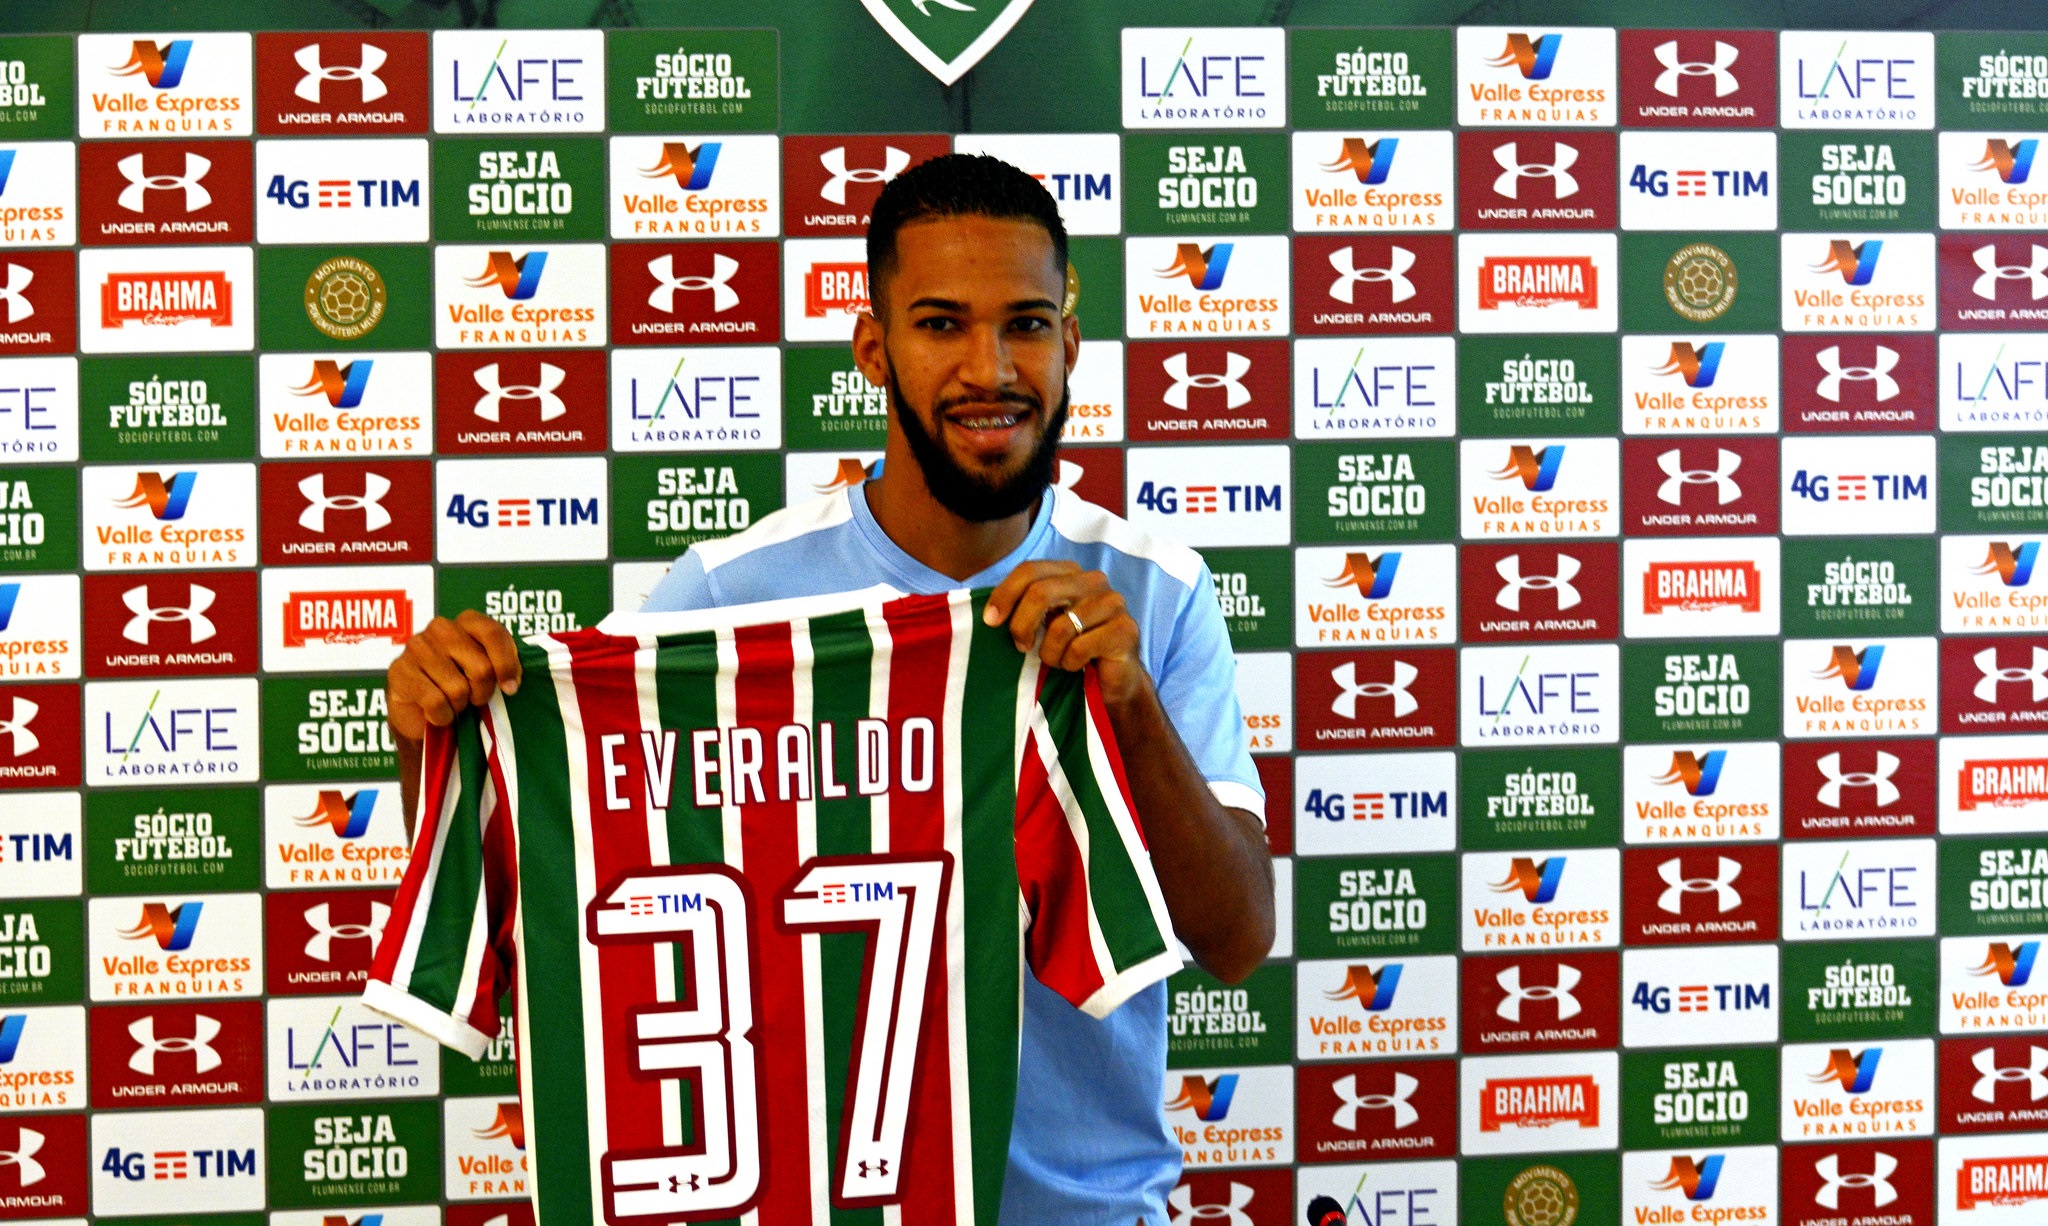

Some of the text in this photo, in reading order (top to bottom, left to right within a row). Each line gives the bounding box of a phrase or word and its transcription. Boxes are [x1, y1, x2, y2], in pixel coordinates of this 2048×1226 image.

[655, 47, 732, 78] SÓCIO
[1140, 44, 1267, 102] LAFE
[1335, 46, 1409, 76] SÓCIO
[452, 47, 584, 106] LAFE
[636, 77, 751, 98] FUTEBOL
[1317, 75, 1427, 96] FUTEBOL
[92, 91, 241, 117] Valle Express
[1470, 82, 1605, 107] Valle Express
[277, 110, 405, 125] UNDER ARMOUR
[452, 108, 584, 125] LABORATÓRIO
[1139, 104, 1266, 120] LABORATÓRIO
[1481, 107, 1598, 123] FRANQUIAS
[103, 117, 233, 134] FRANQUIAS
[478, 151, 560, 178] SEJA
[1167, 146, 1246, 172] SEJA
[1821, 144, 1894, 170] SEJA
[266, 174, 421, 209] 4G TIM
[1053, 173, 1112, 201] TIM
[1158, 173, 1259, 209] SÓCIO
[1629, 164, 1769, 197] 4G TIM
[1812, 171, 1906, 205] SÓCIO
[468, 179, 573, 215] SÓCIO
[623, 192, 769, 218] Valle Express
[1305, 187, 1443, 212] Valle Express
[1951, 188, 2003, 207] Valle
[803, 213, 855, 227] UNDER
[1316, 212, 1435, 228] FRANQUIAS
[1477, 206, 1595, 220] UNDER ARMOUR
[100, 219, 229, 235] UNDER ARMOUR
[634, 218, 761, 235] FRANQUIAS
[315, 259, 376, 281] MOVIMENTO
[1492, 264, 1586, 295] BRAHMA
[116, 280, 218, 312] BRAHMA
[1139, 293, 1279, 317] Valle Express
[631, 320, 757, 335] UNDER ARMOUR
[1149, 318, 1271, 334] FRANQUIAS
[1957, 309, 2005, 321] UNDER
[1503, 353, 1575, 383] SÓCIO
[129, 374, 208, 406] SÓCIO
[631, 364, 760, 424] LAFE
[1312, 354, 1436, 412] LAFE
[1485, 382, 1593, 403] FUTEBOL
[1634, 390, 1768, 414] Valle Express
[109, 405, 226, 426] FUTEBOL
[1146, 416, 1268, 432] UNDER ARMOUR
[1312, 414, 1436, 430] LABORATÓRIO
[1644, 415, 1761, 430] FRANQUIAS
[631, 426, 760, 443] LABORATÓRIO
[1337, 454, 1414, 480] SEJA
[656, 467, 738, 494] SEJA
[1136, 481, 1283, 515] 4G TIM
[1328, 482, 1426, 516] SÓCIO
[446, 493, 600, 529] 4G TIM
[647, 495, 750, 530] SÓCIO
[96, 523, 245, 548] Valle Express
[108, 549, 238, 565] FRANQUIAS
[1825, 556, 1894, 585] SÓCIO
[1656, 569, 1748, 599] BRAHMA
[1808, 584, 1911, 604] FUTEBOL
[485, 583, 564, 615] SÓCIO
[297, 599, 399, 630] BRAHMA
[1308, 601, 1446, 626] Valle Express
[1479, 618, 1597, 633] UNDER ARMOUR
[1319, 627, 1438, 642] FRANQUIAS
[105, 651, 234, 667] UNDER ARMOUR
[1664, 655, 1739, 680] SEJA
[308, 689, 390, 717] SEJA
[1478, 662, 1599, 719] LAFE
[1654, 682, 1750, 716] SÓCIO
[104, 697, 239, 757] LAFE
[1477, 721, 1601, 737] LABORATÓRIO
[104, 758, 239, 776] LABORATÓRIO
[602, 716, 936, 811] EVERALDO
[1505, 766, 1577, 796] SÓCIO
[1304, 788, 1449, 822] 4G TIM
[1487, 796, 1595, 816] FUTEBOL
[134, 807, 213, 839] SÓCIO
[1801, 813, 1914, 829] UNDER ARMOUR
[9, 833, 73, 862] TIM
[115, 837, 232, 859] FUTEBOL
[279, 841, 335, 863] Valle
[849, 881, 895, 903] TIM
[1339, 870, 1416, 895] SEJA
[1799, 857, 1918, 912] LAFE
[657, 892, 703, 915] TIM
[1329, 896, 1427, 931] SÓCIO
[1799, 915, 1918, 931] LABORATÓRIO
[102, 953, 251, 978] Valle Express
[287, 970, 340, 984] UNDER
[114, 979, 244, 996] FRANQUIAS
[1175, 984, 1249, 1014] SÓCIO
[1632, 981, 1771, 1014] 4G TIM
[589, 851, 952, 1221] 37
[1310, 1013, 1447, 1037] Valle Express
[287, 1012, 419, 1072] LAFE
[1320, 1038, 1439, 1053] FRANQUIAS
[111, 1080, 239, 1098] UNDER ARMOUR
[287, 1074, 419, 1092] LABORATÓRIO
[1494, 1085, 1586, 1115] BRAHMA
[1793, 1095, 1924, 1119] Valle Express
[313, 1116, 395, 1143] SEJA
[1202, 1123, 1284, 1148] Express
[1803, 1120, 1917, 1135] FRANQUIAS
[1316, 1135, 1434, 1152] UNDER ARMOUR
[101, 1147, 257, 1181] 4G TIM
[303, 1144, 408, 1180] SÓCIO
[1635, 1204, 1768, 1223] Valle Express
